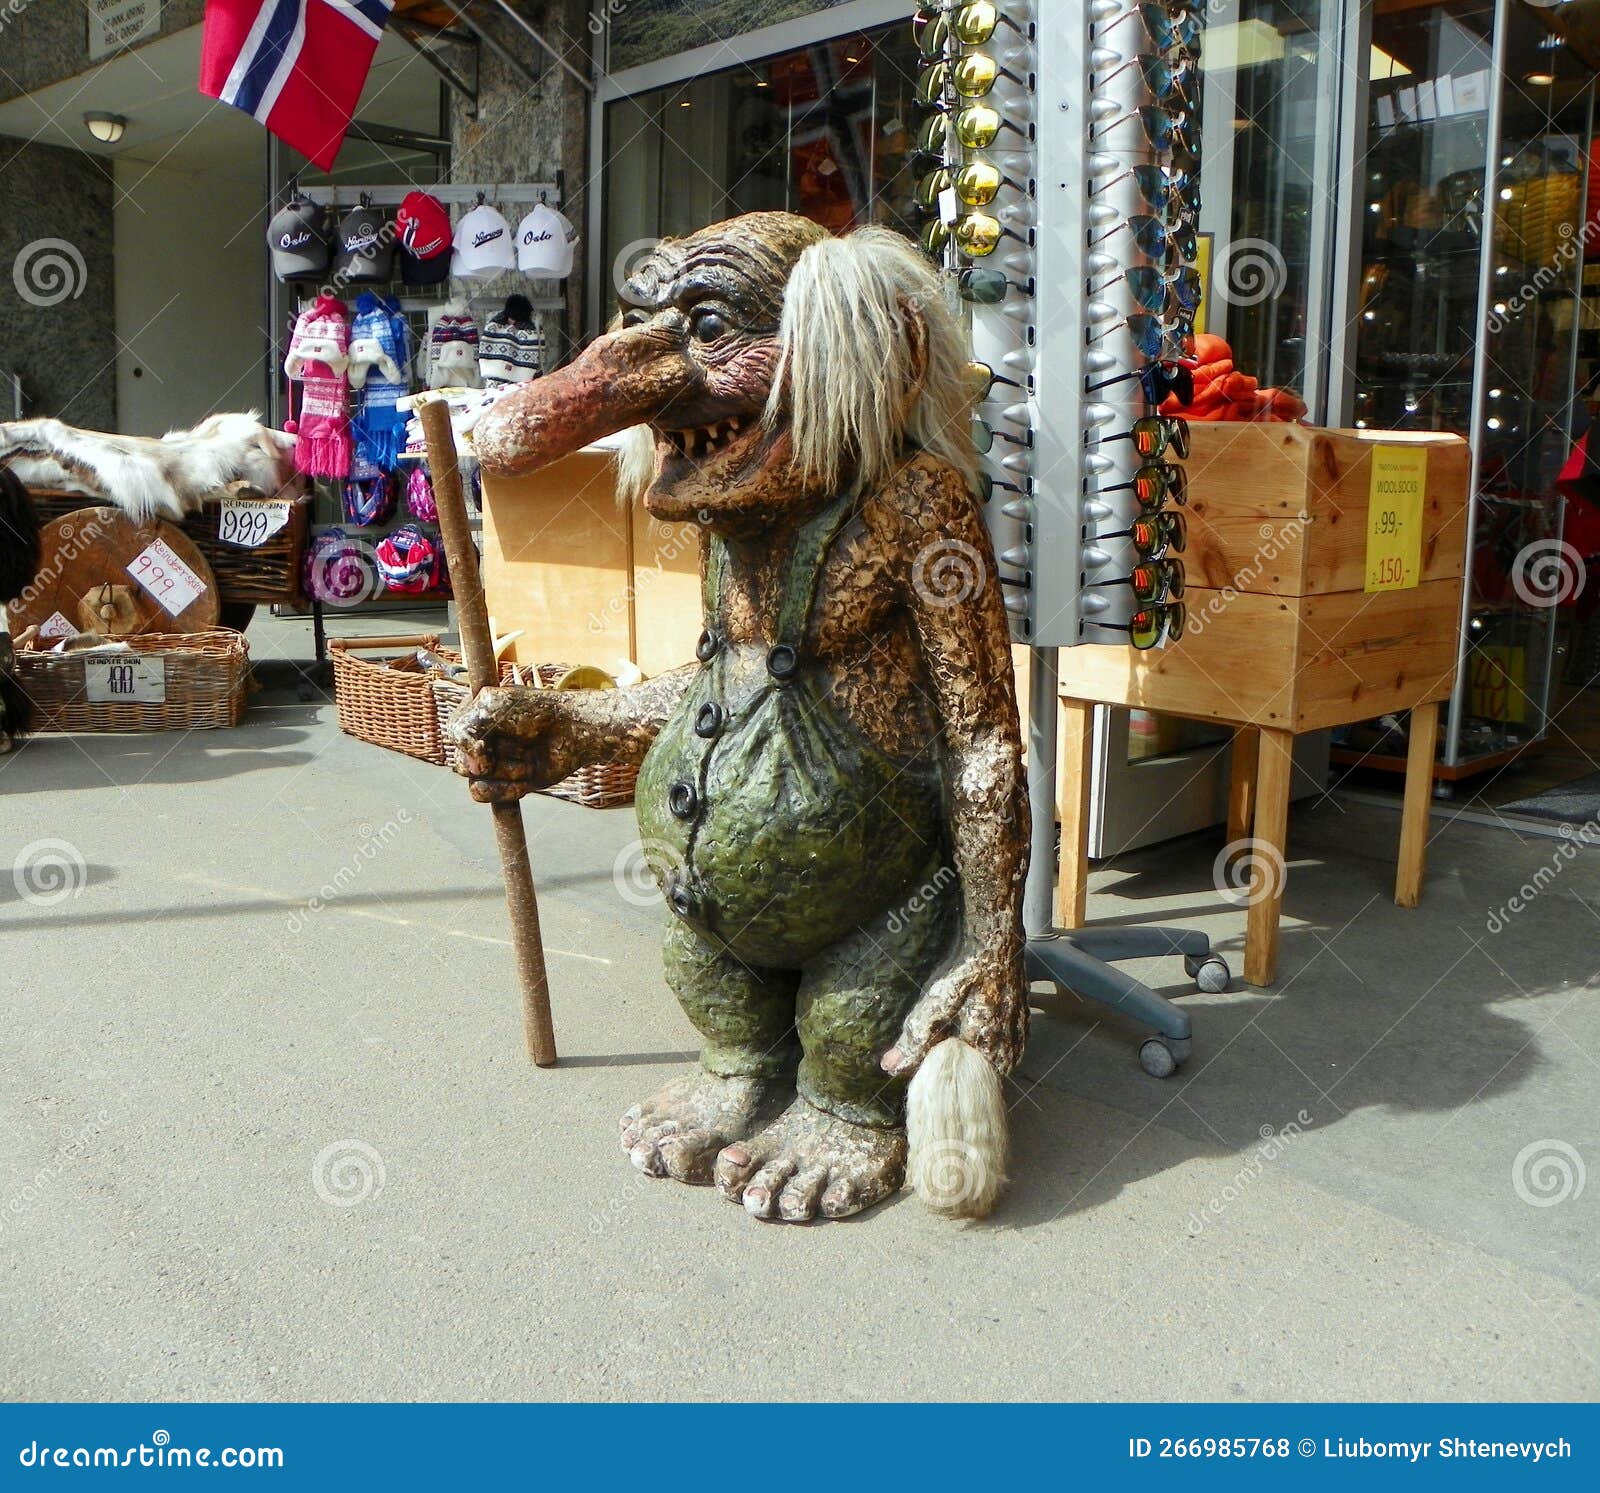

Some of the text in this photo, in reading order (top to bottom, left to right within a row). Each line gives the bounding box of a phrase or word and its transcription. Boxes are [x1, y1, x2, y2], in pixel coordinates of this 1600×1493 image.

[280, 232, 312, 248] Oslo
[523, 230, 552, 246] Oslo
[223, 510, 268, 545] 999
